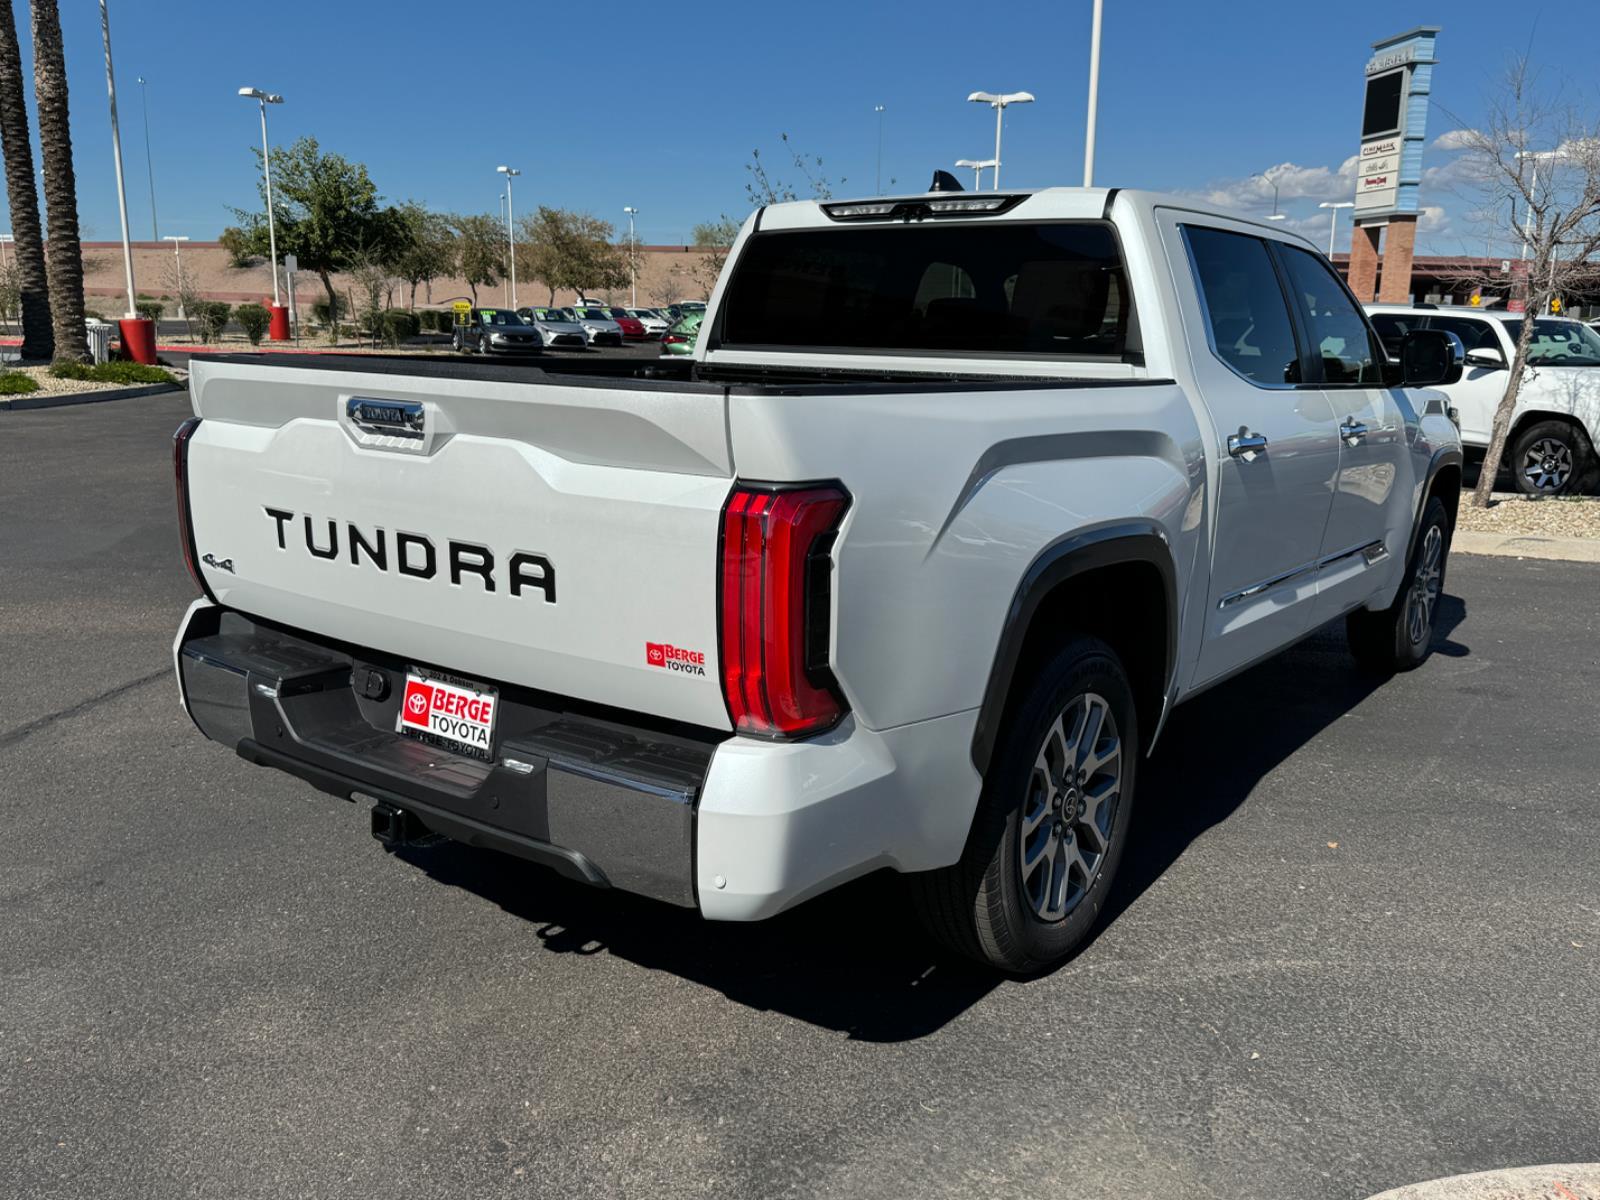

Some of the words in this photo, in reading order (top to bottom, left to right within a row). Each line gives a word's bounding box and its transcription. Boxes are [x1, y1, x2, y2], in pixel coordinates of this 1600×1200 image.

[459, 313, 466, 321] 5
[262, 504, 557, 604] TUNDRA
[665, 644, 705, 665] BERGE
[666, 660, 706, 676] TOYOTA
[432, 688, 492, 724] BERGE
[431, 714, 488, 745] TOYOTA
